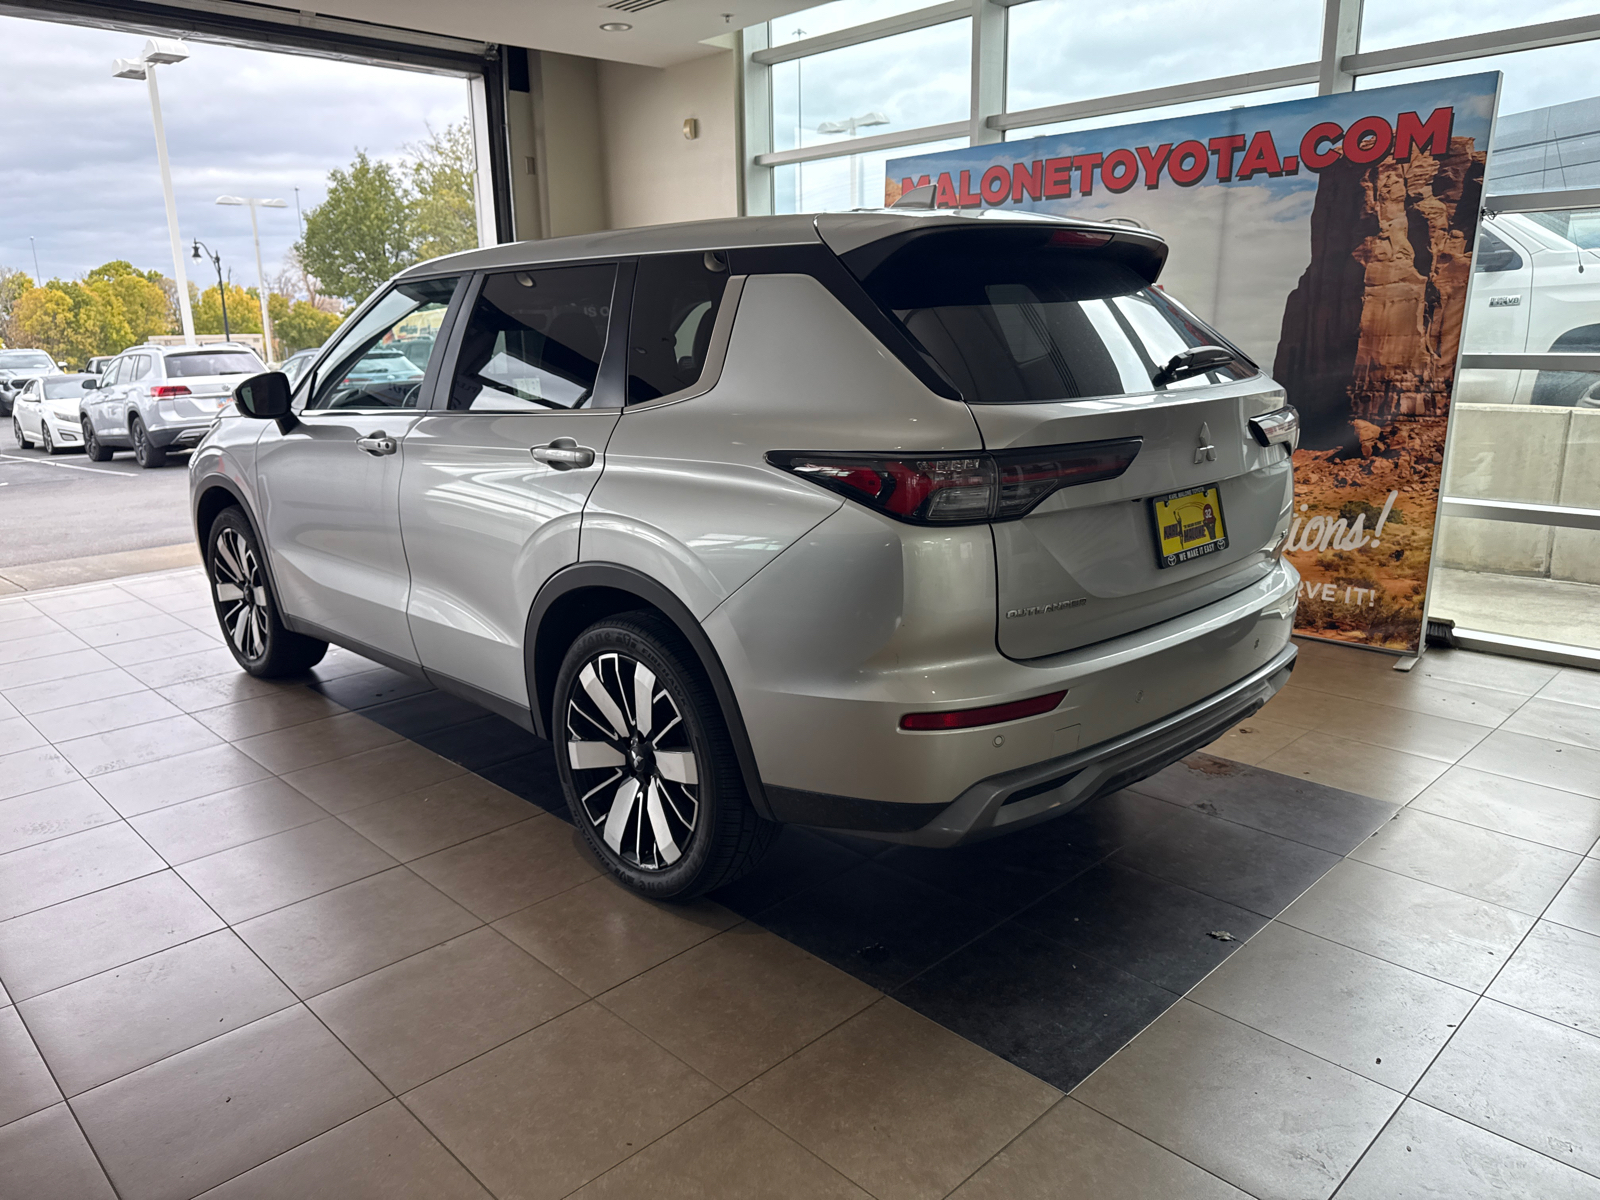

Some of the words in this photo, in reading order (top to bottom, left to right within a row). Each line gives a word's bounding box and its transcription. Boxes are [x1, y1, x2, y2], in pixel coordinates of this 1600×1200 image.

[1204, 508, 1213, 519] 32
[1282, 490, 1398, 552] ions!
[1179, 553, 1187, 561] WE
[1187, 548, 1199, 559] MAKE
[1204, 543, 1215, 554] EASY
[1344, 586, 1376, 607] IT!
[1006, 597, 1087, 619] OUTLANDER
